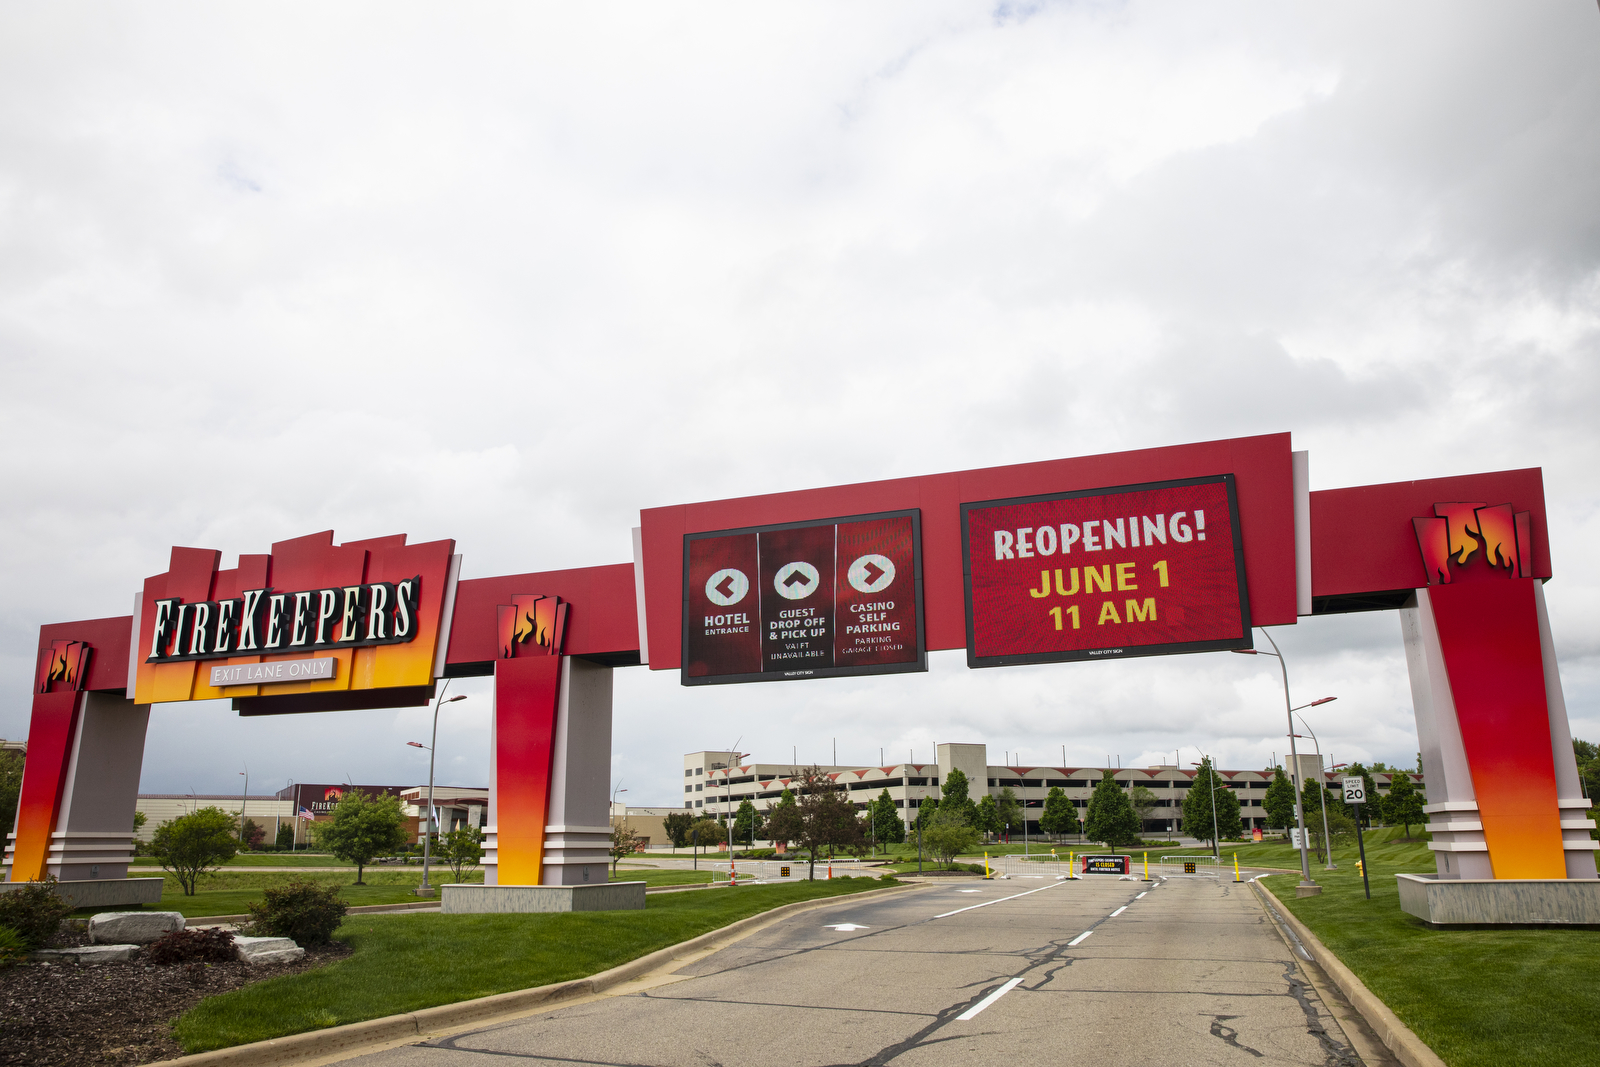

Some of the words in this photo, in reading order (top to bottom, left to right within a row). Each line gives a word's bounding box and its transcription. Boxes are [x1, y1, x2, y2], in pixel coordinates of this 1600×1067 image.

[994, 510, 1206, 560] REOPENING!
[1029, 562, 1138, 598] JUNE
[1152, 560, 1169, 587] 1
[779, 607, 815, 618] GUEST
[850, 601, 895, 613] CASINO
[704, 612, 750, 627] HOTEL
[859, 612, 887, 623] SELF
[1049, 605, 1080, 630] 11
[1098, 597, 1157, 625] AM
[770, 619, 800, 629] DROP
[804, 617, 825, 627] OFF
[846, 621, 900, 634] PARKING
[705, 626, 749, 635] ENTRANCE
[769, 631, 778, 640] &
[781, 629, 807, 639] PICK
[811, 628, 826, 637] UP
[855, 635, 892, 645] PARKING
[771, 650, 825, 660] UNAVAILABLE
[215, 668, 241, 682] EXIT
[248, 665, 283, 679] LANE
[289, 661, 327, 676] ONLY
[1346, 789, 1363, 799] 20
